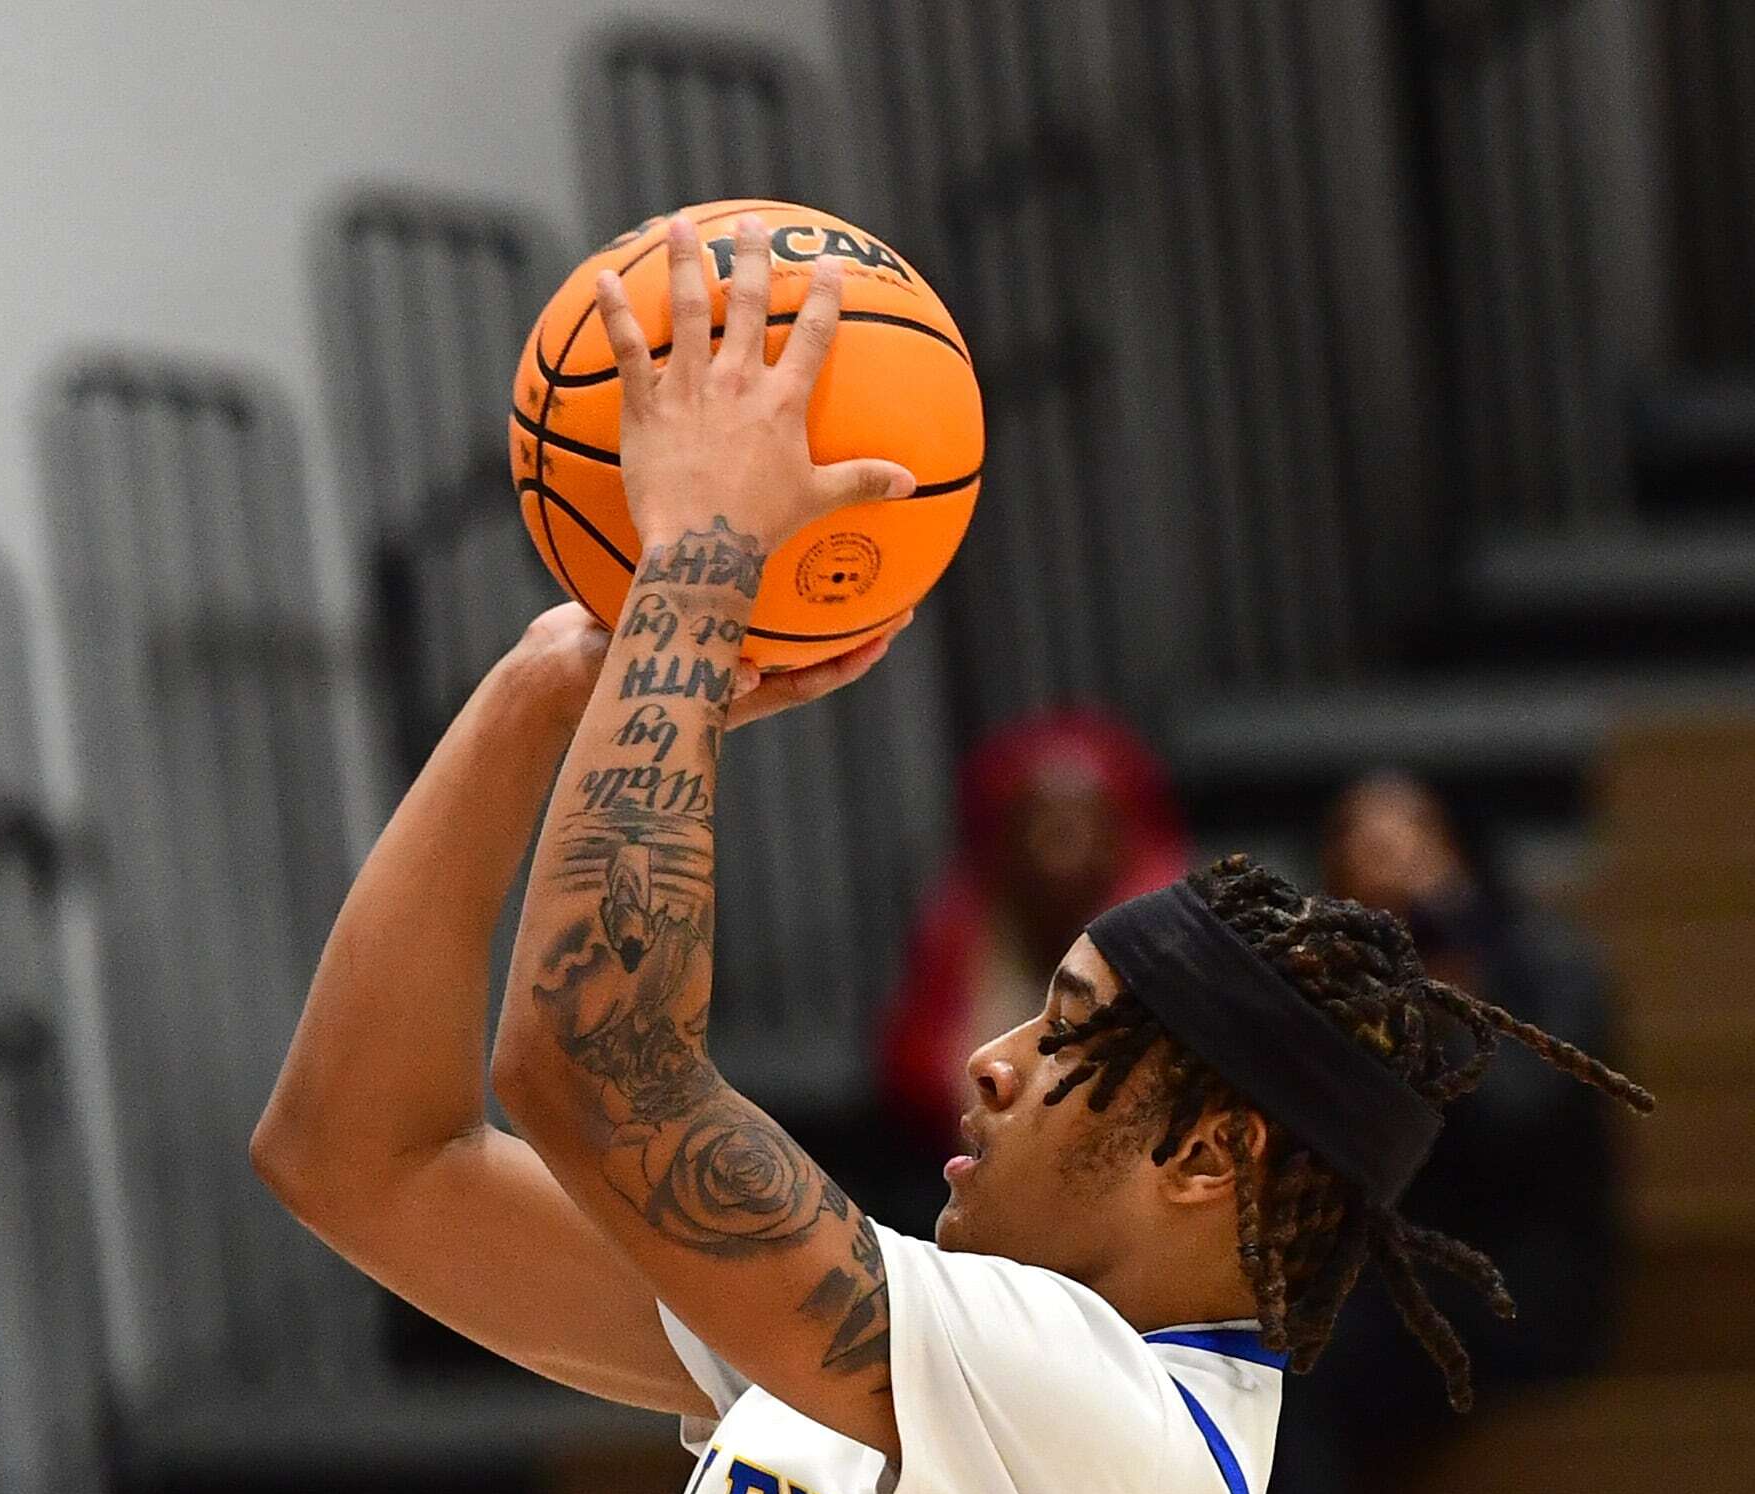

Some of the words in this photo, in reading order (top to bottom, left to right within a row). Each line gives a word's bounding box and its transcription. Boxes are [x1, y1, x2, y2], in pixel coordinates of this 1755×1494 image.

[641, 541, 766, 599] GHT
[621, 592, 678, 652] by
[691, 614, 749, 646] ot
[618, 656, 731, 713] AITH
[611, 703, 678, 763] by
[577, 765, 710, 812] Walk
